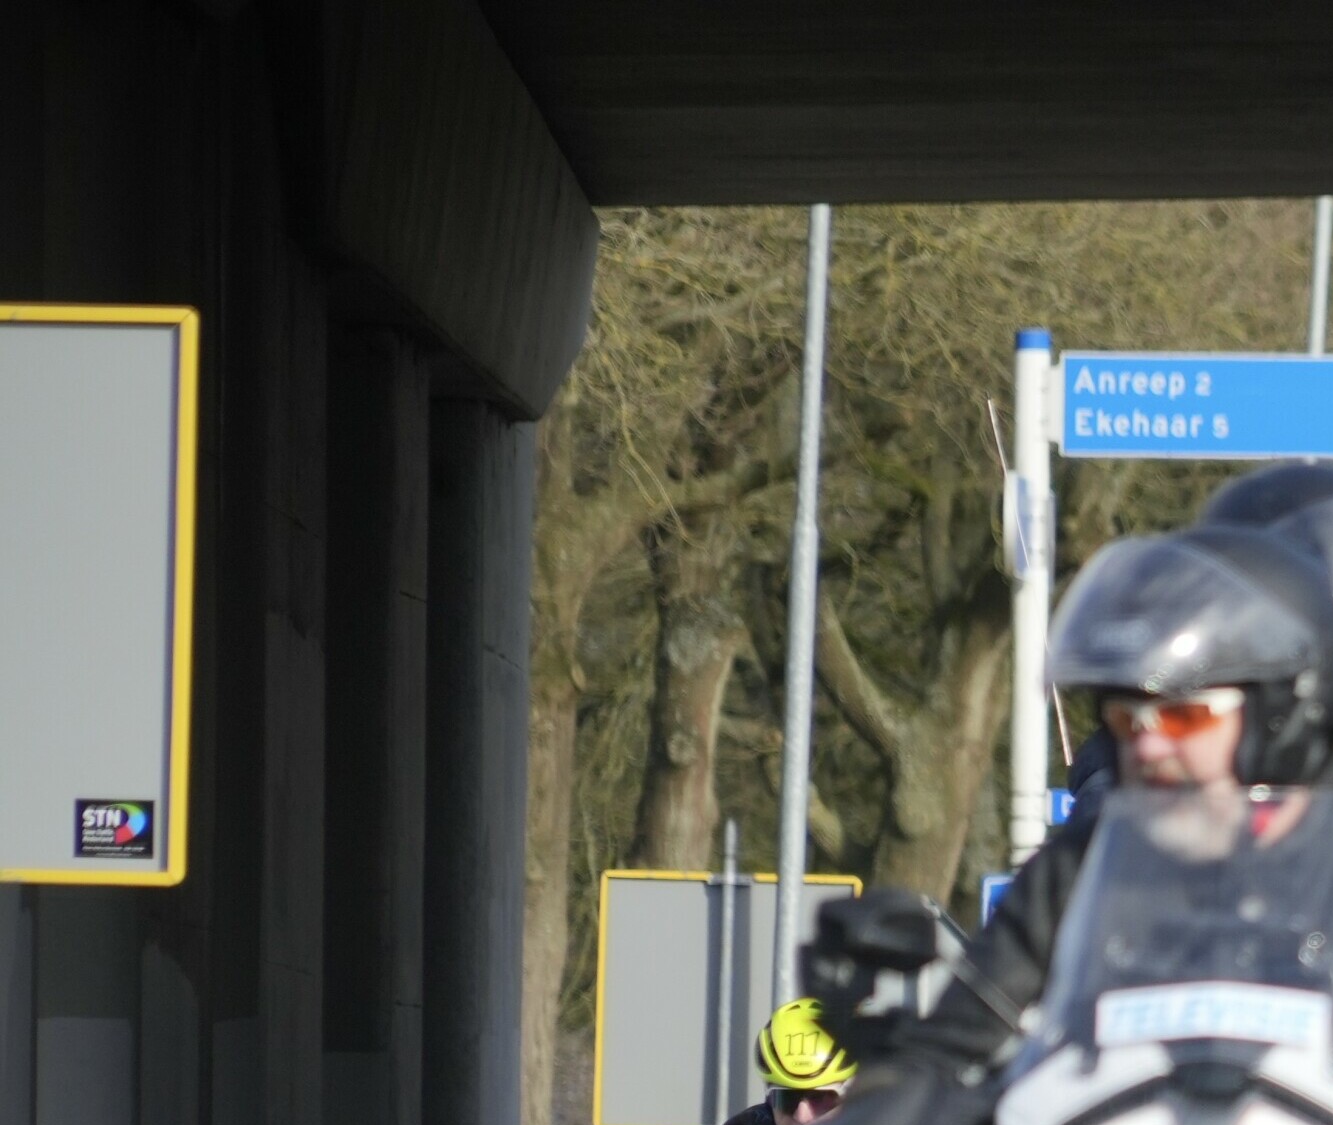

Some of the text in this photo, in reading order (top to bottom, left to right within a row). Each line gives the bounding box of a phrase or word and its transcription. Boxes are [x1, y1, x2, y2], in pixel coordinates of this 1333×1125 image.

[1074, 365, 1211, 400] Anreep 2
[1075, 407, 1229, 439] Ekehaar 5
[82, 808, 120, 828] STN
